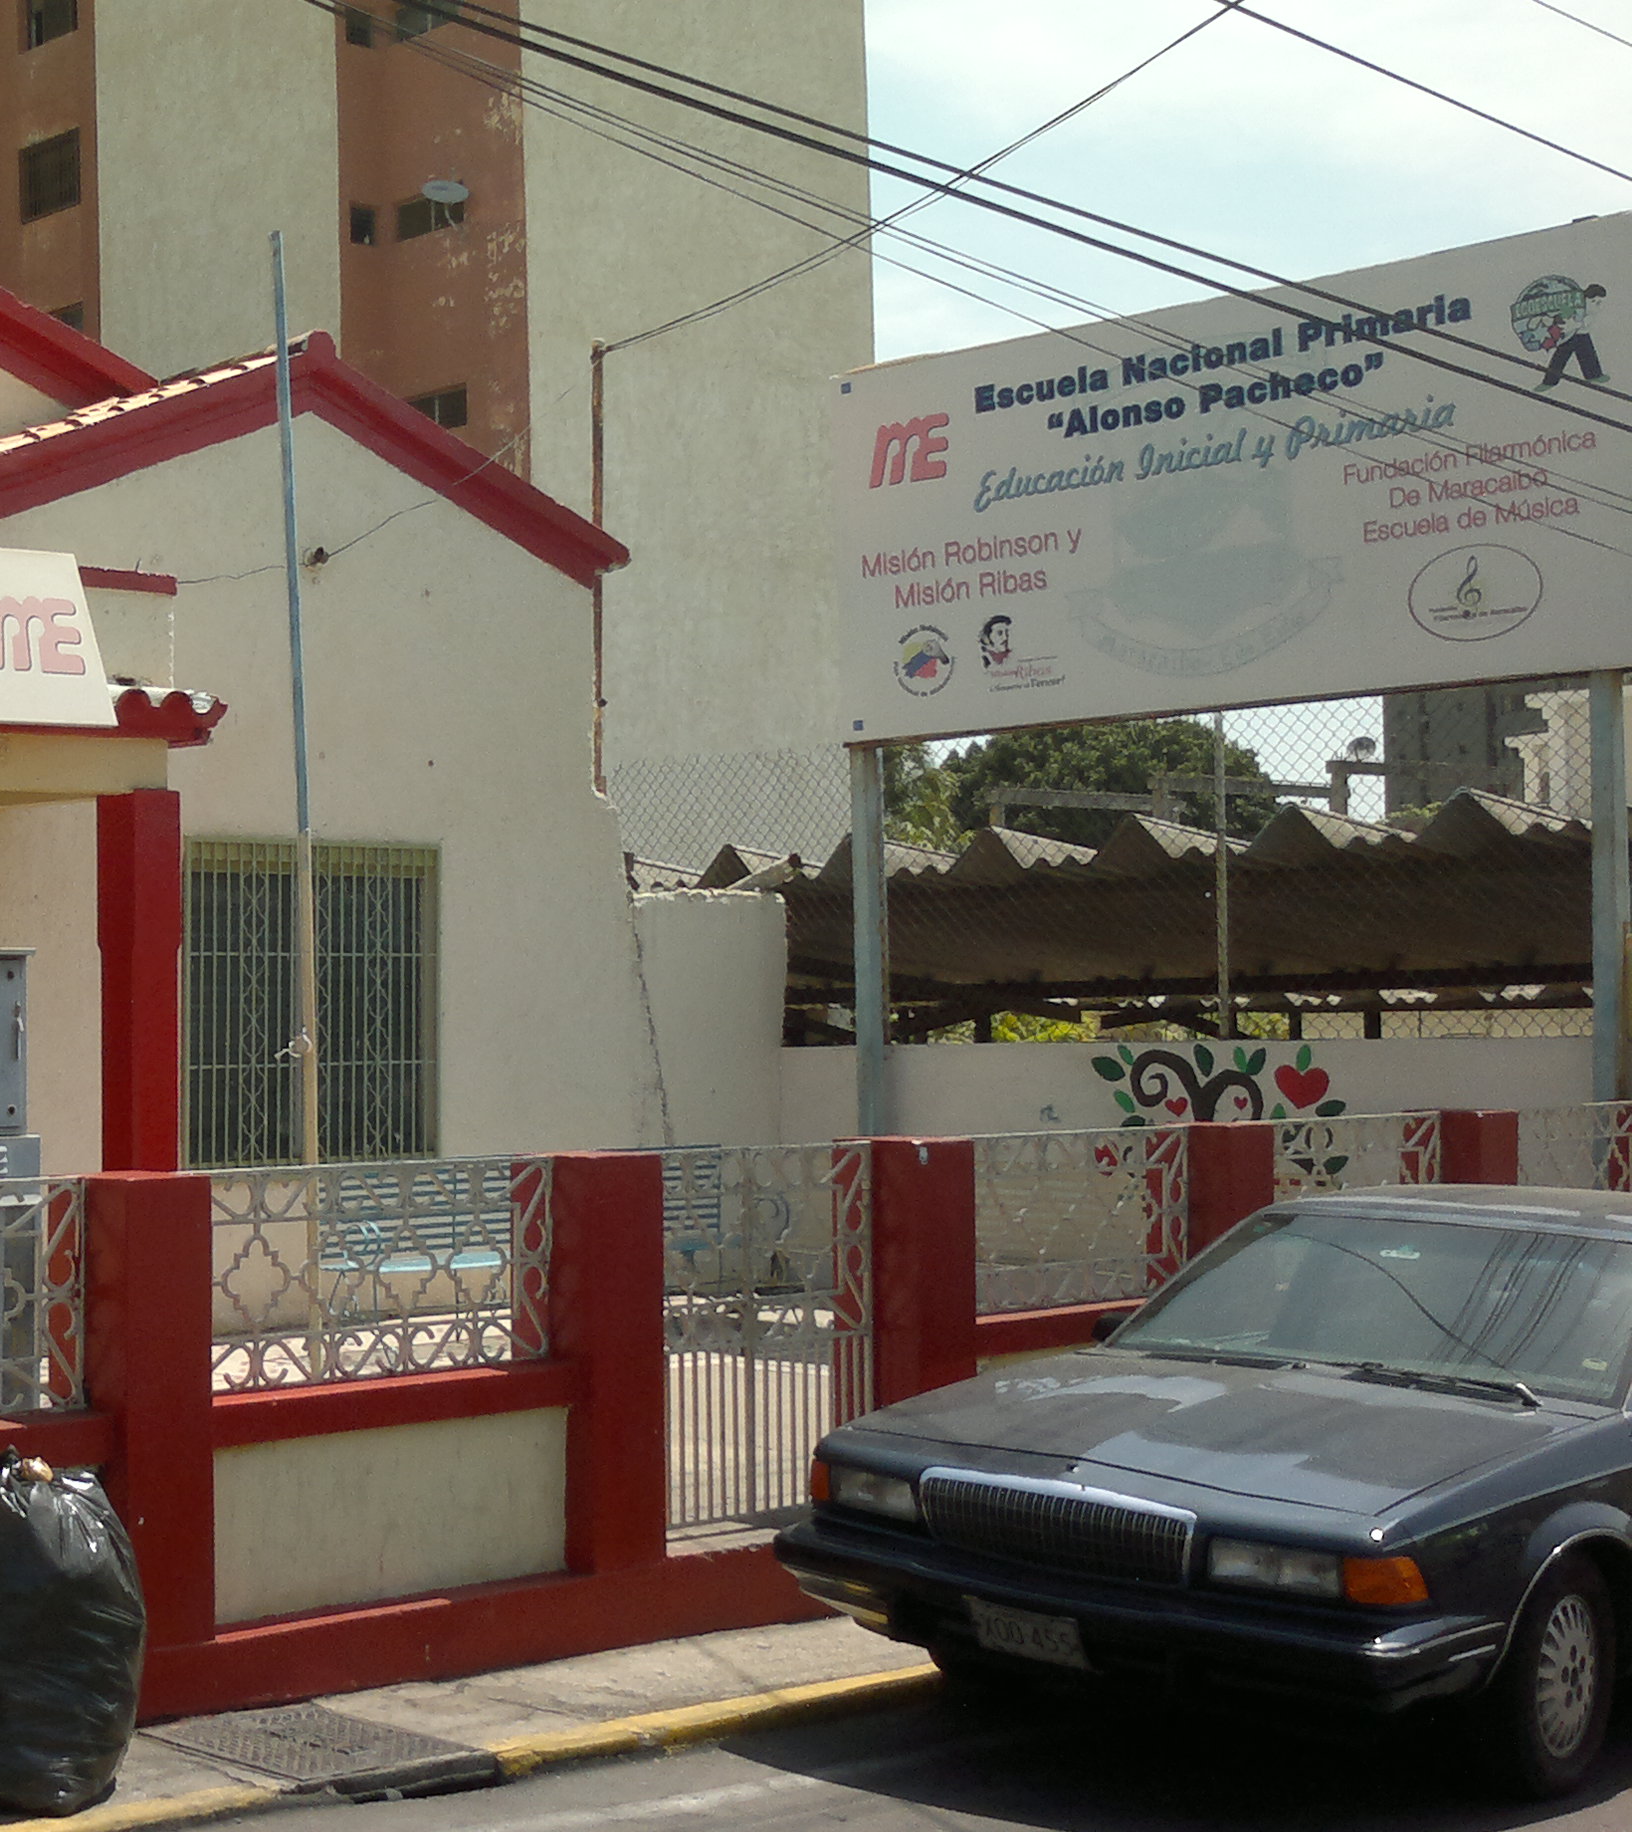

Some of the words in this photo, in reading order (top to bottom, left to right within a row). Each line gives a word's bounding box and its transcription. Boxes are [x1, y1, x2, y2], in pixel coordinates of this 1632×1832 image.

[973, 365, 1109, 414] Escuela
[1121, 327, 1283, 386] Nacional
[1296, 293, 1472, 354] Primaria
[973, 453, 1124, 513] Educación
[1136, 428, 1247, 480] Inicial
[1251, 434, 1275, 469] y
[1286, 394, 1456, 460] Primaria
[1342, 450, 1458, 485] Fundación
[1465, 430, 1597, 465] Filarmónica
[1389, 487, 1421, 509] De
[1428, 468, 1548, 503] Maracaibo
[1363, 512, 1450, 544] Escuela
[1457, 506, 1487, 530] de
[1495, 497, 1580, 525] Música
[861, 547, 936, 579] Misión
[944, 531, 1059, 568] Robinson
[1067, 528, 1082, 554] y
[894, 577, 970, 609] Misión
[978, 568, 1048, 598] Ribas
